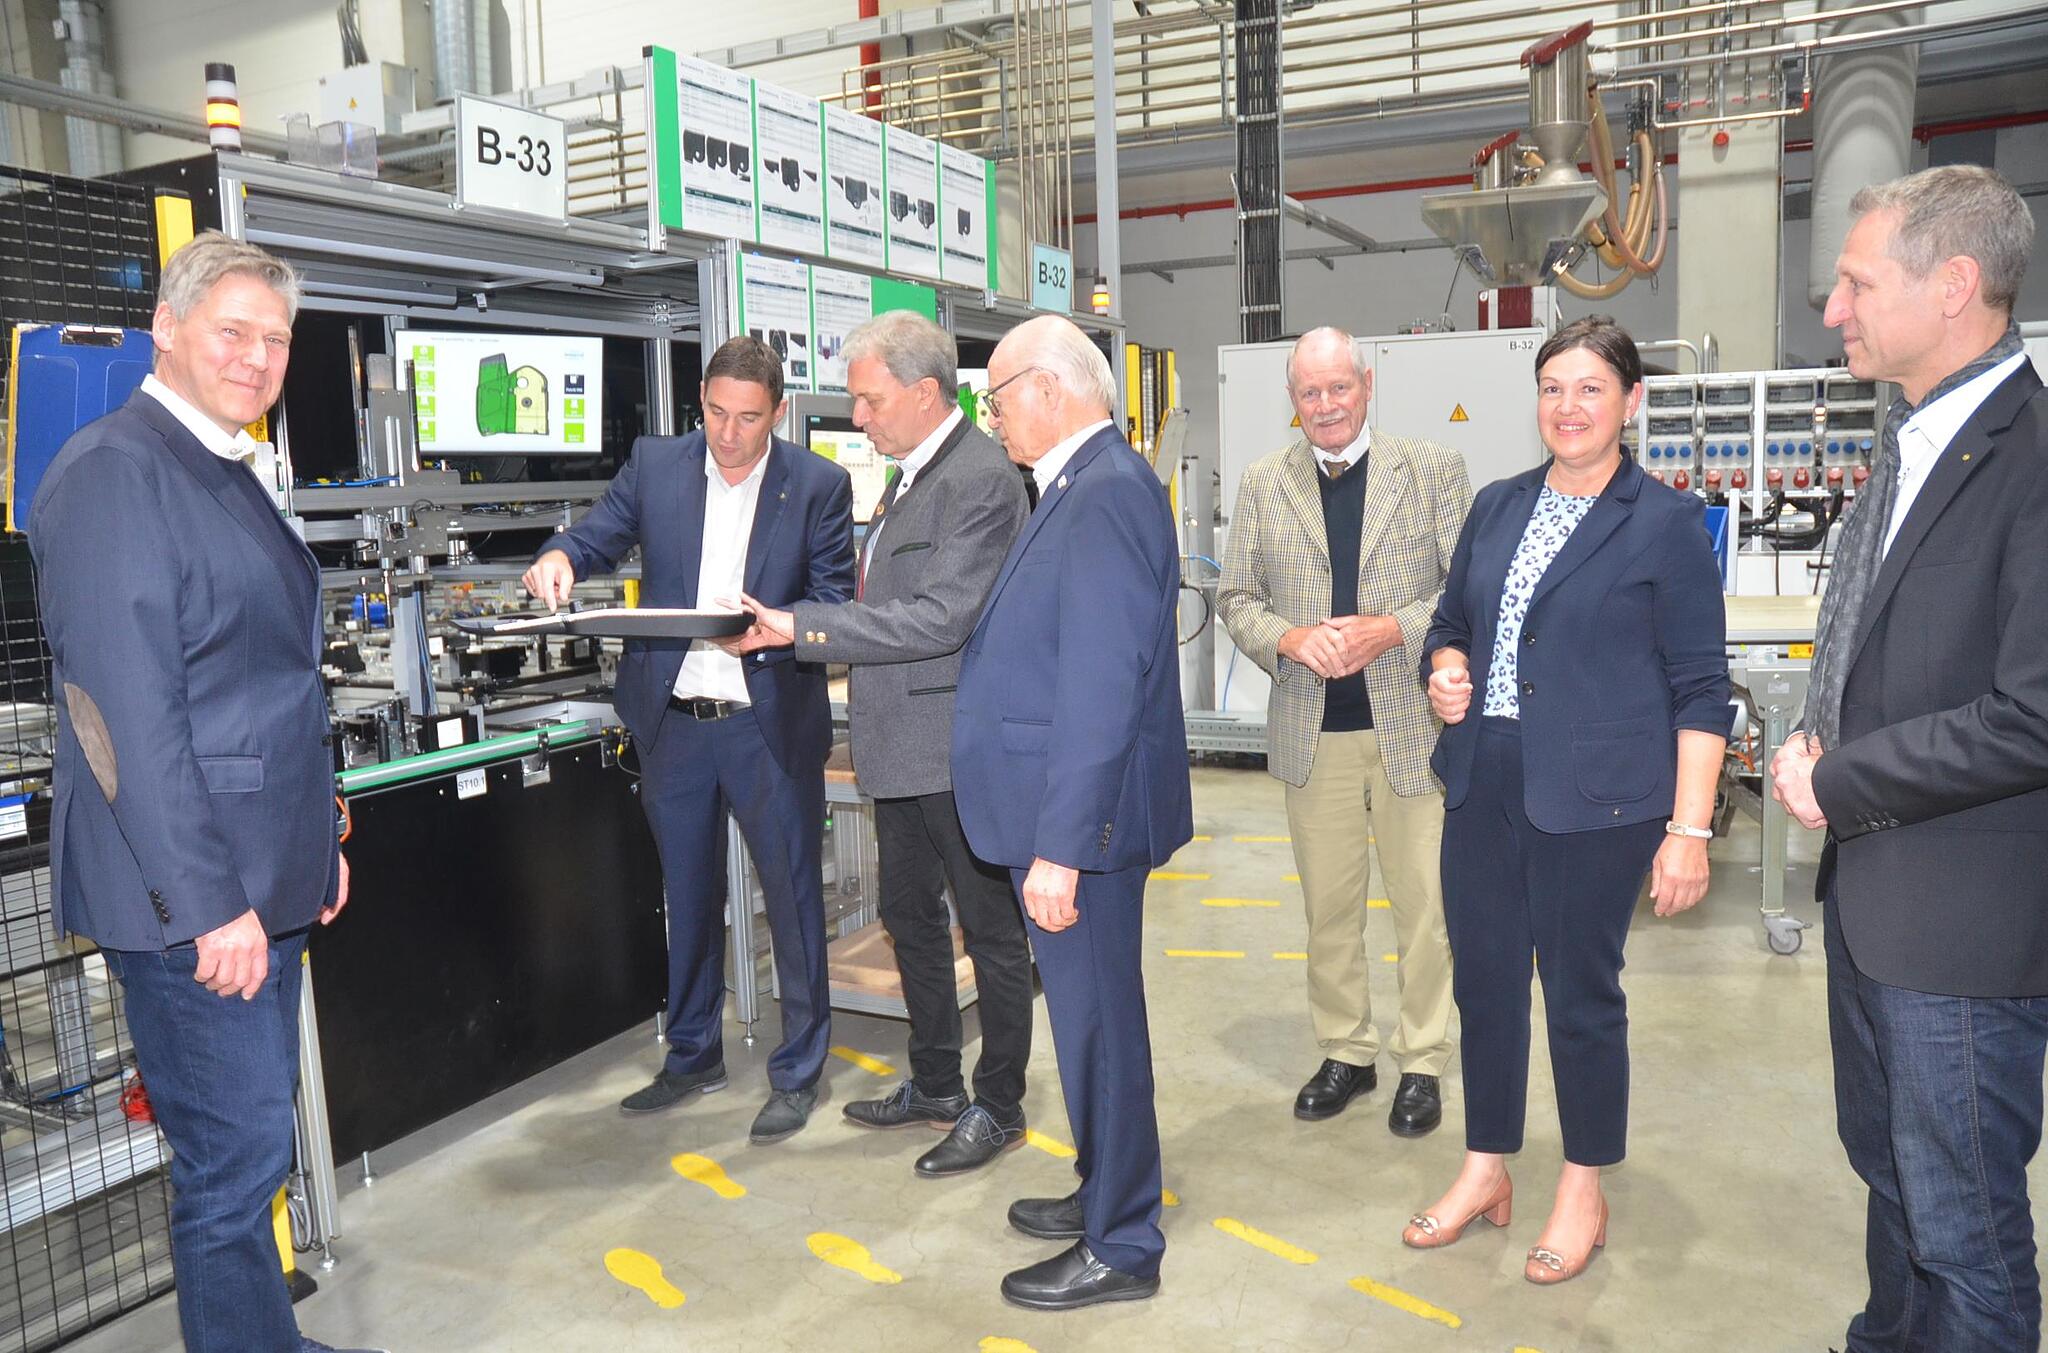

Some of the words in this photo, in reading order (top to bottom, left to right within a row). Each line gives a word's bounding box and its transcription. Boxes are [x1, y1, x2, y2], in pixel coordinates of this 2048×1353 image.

[477, 125, 552, 177] B-33
[1038, 261, 1066, 289] B-32
[1509, 340, 1534, 350] B-32
